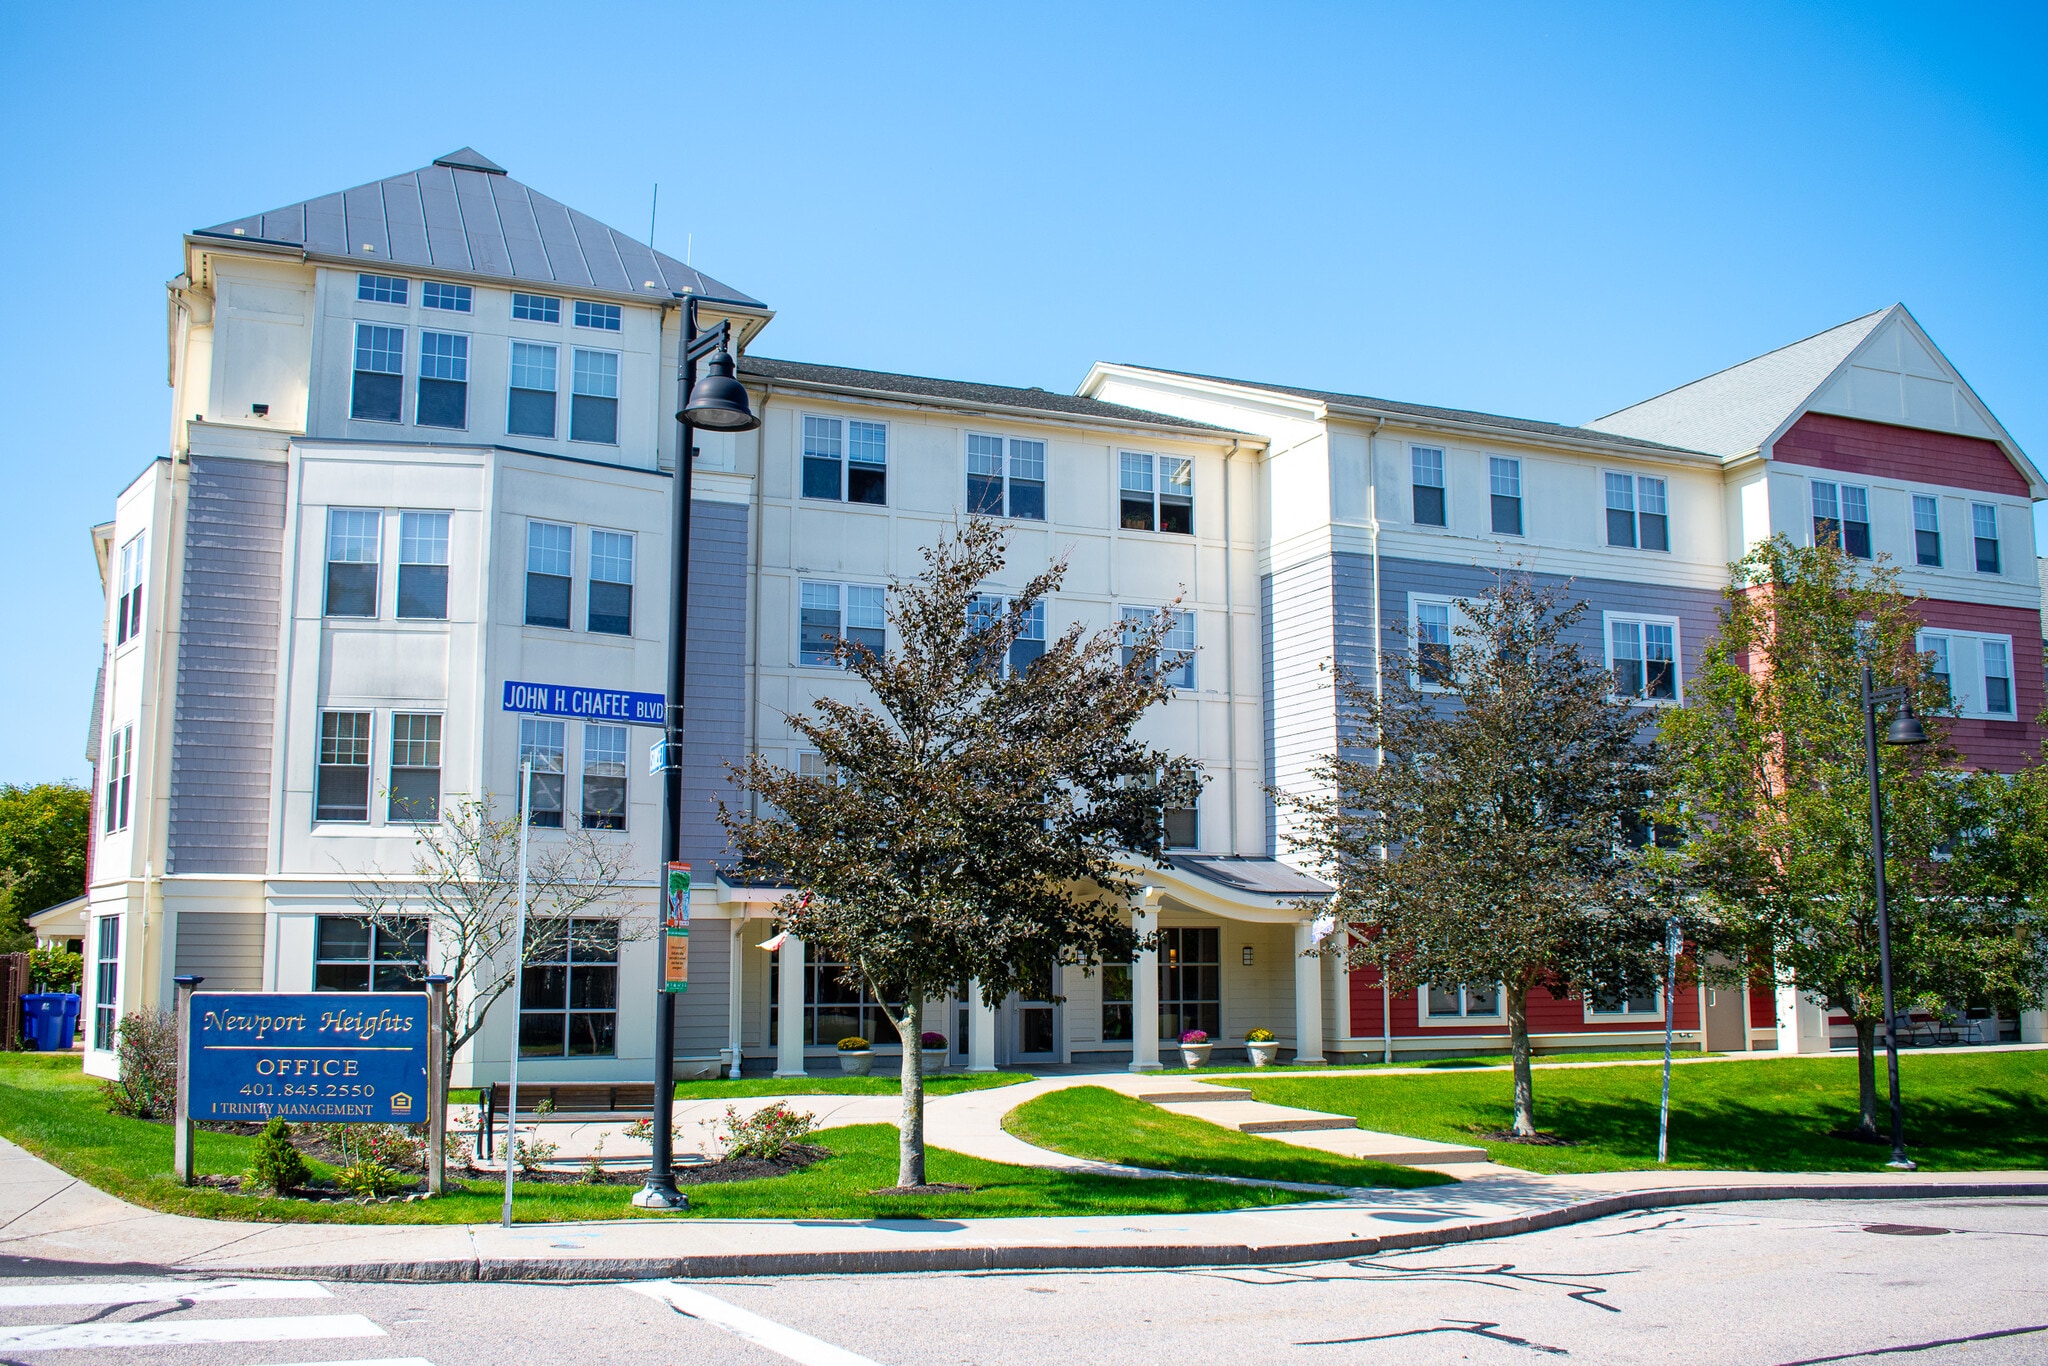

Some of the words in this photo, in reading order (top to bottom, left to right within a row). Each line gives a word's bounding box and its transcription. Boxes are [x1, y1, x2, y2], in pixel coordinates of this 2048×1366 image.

[504, 685, 549, 710] JOHN
[554, 689, 568, 712] H.
[572, 690, 630, 717] CHAFEE
[636, 701, 664, 719] BLVD
[203, 1008, 306, 1040] Newport
[319, 1008, 414, 1040] Heights
[256, 1059, 359, 1077] OFFICE
[240, 1084, 375, 1098] 401.845.2550
[220, 1102, 274, 1114] TRINITY
[277, 1103, 374, 1116] MANAGEMENT
